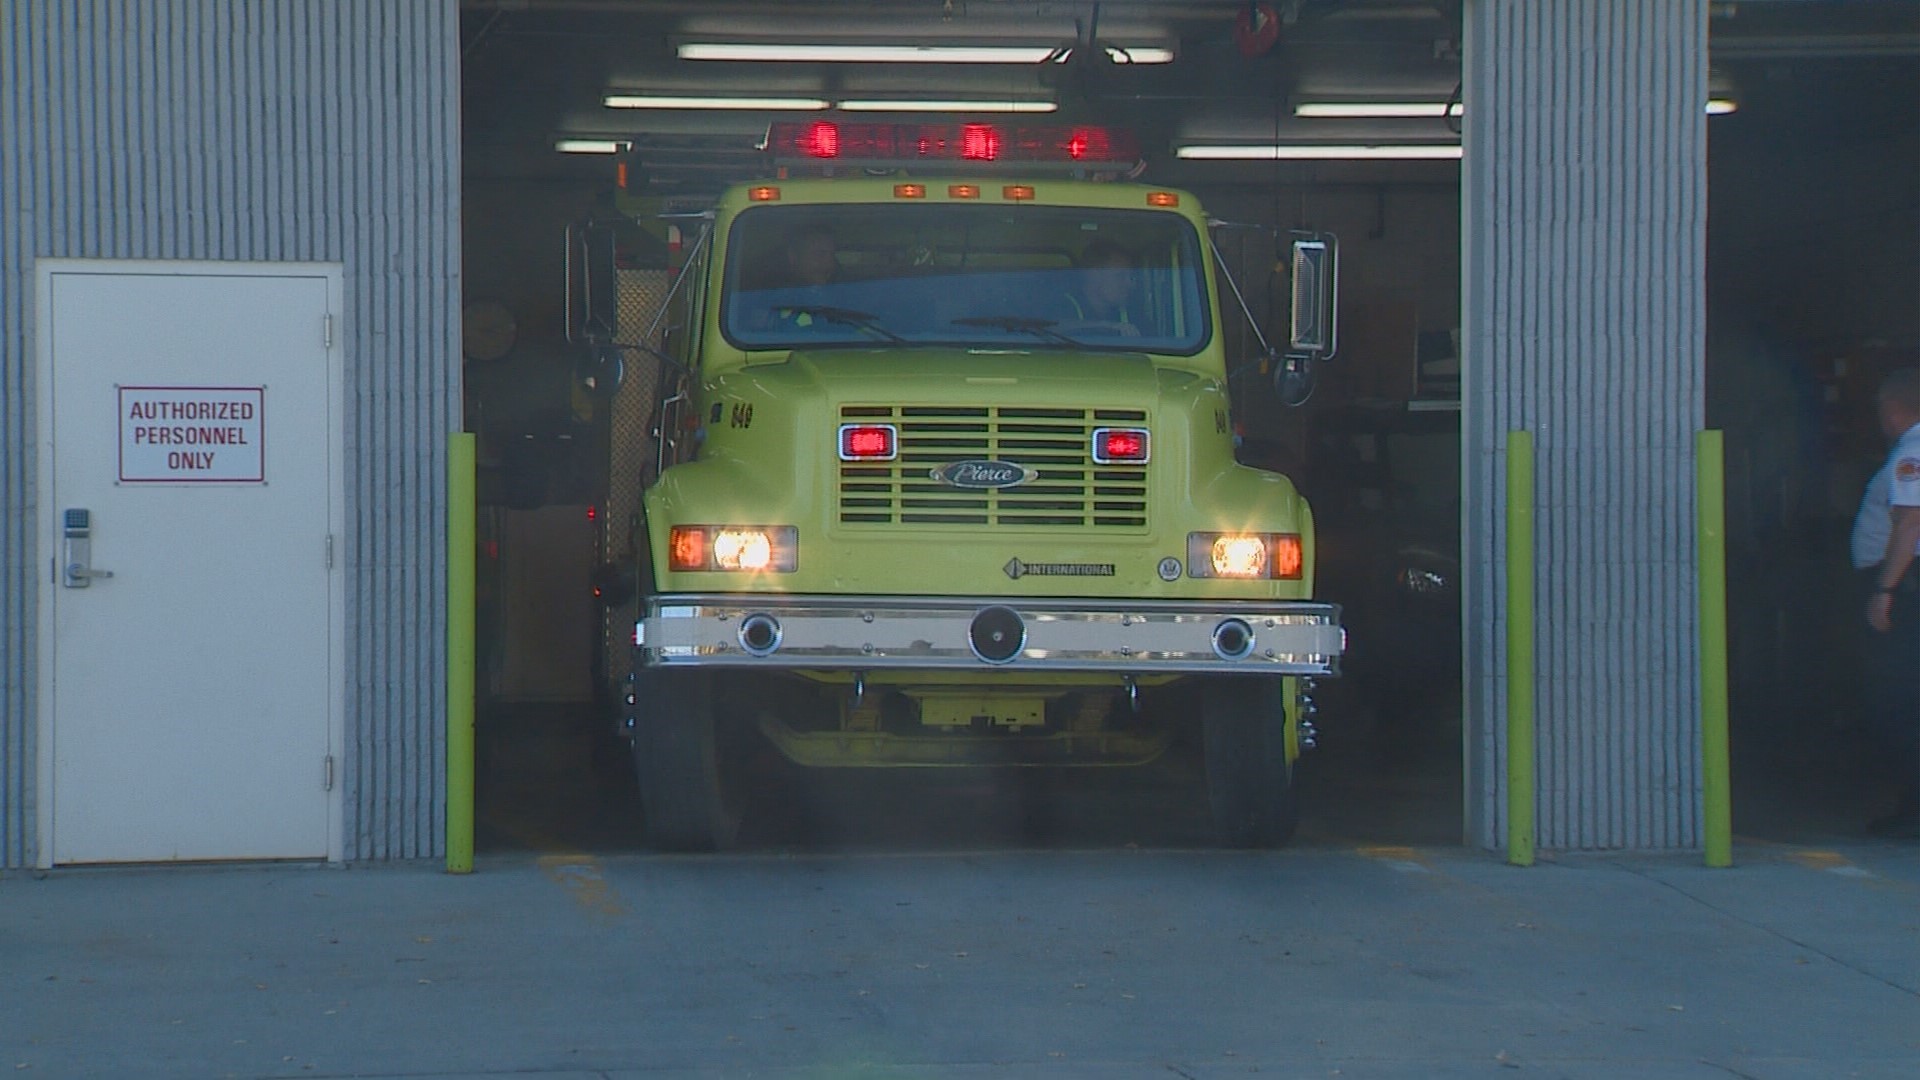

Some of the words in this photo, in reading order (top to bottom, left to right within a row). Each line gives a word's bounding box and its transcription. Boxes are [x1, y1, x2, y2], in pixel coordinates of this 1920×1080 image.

[130, 402, 254, 420] AUTHORIZED
[135, 427, 248, 445] PERSONNEL
[168, 452, 215, 470] ONLY
[953, 463, 1012, 482] Pierce
[1028, 564, 1114, 576] INTERNATIONAL
